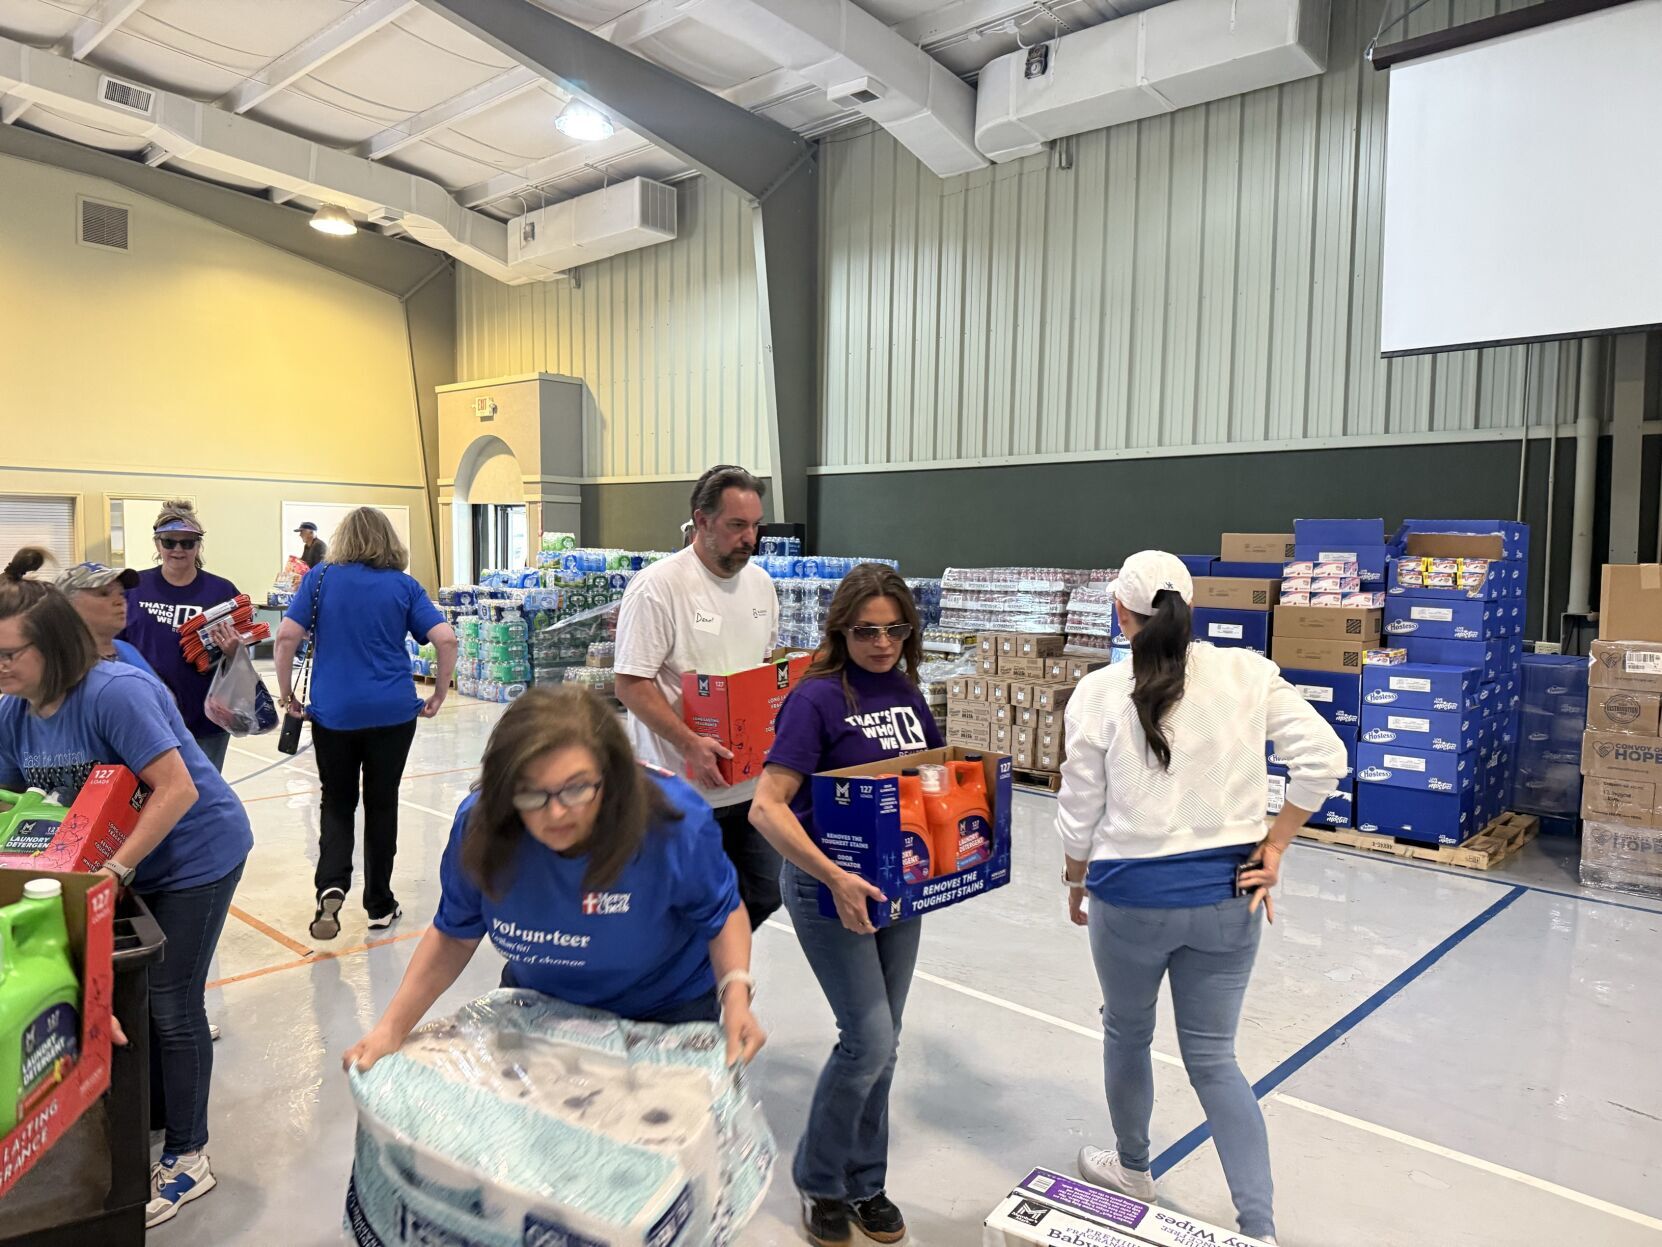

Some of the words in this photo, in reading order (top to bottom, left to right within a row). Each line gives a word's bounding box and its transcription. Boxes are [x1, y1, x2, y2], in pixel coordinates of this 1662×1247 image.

[477, 398, 487, 411] EXIT
[139, 601, 174, 611] THAT'S
[148, 608, 174, 618] WHO
[156, 616, 172, 625] WE
[1389, 622, 1416, 631] Hostess
[1370, 692, 1394, 701] Hostess
[844, 710, 891, 727] THAT'S
[861, 723, 895, 738] WHO
[1367, 731, 1393, 739] Hostess
[878, 737, 900, 750] WE
[1615, 743, 1652, 752] CONVOY
[1614, 749, 1662, 764] HOPE
[1000, 762, 1011, 773] 127
[95, 769, 115, 779] 127
[1363, 770, 1389, 778] Hostess
[860, 785, 873, 794] 127
[826, 832, 850, 841] REMOVES
[904, 836, 914, 844] 127
[958, 831, 980, 847] LAUNDRY
[821, 837, 849, 847] TOUGHEST
[850, 841, 869, 849] STAINS
[959, 836, 985, 853] DETERGENT
[922, 876, 961, 897] REMOVES
[961, 870, 978, 884] THE
[911, 890, 957, 912] TOUGHEST
[957, 879, 985, 898] STAINS
[22, 1032, 57, 1073] LAUNDRY
[1154, 1212, 1217, 1243] Wipes
[1160, 1224, 1188, 1241] FREE
